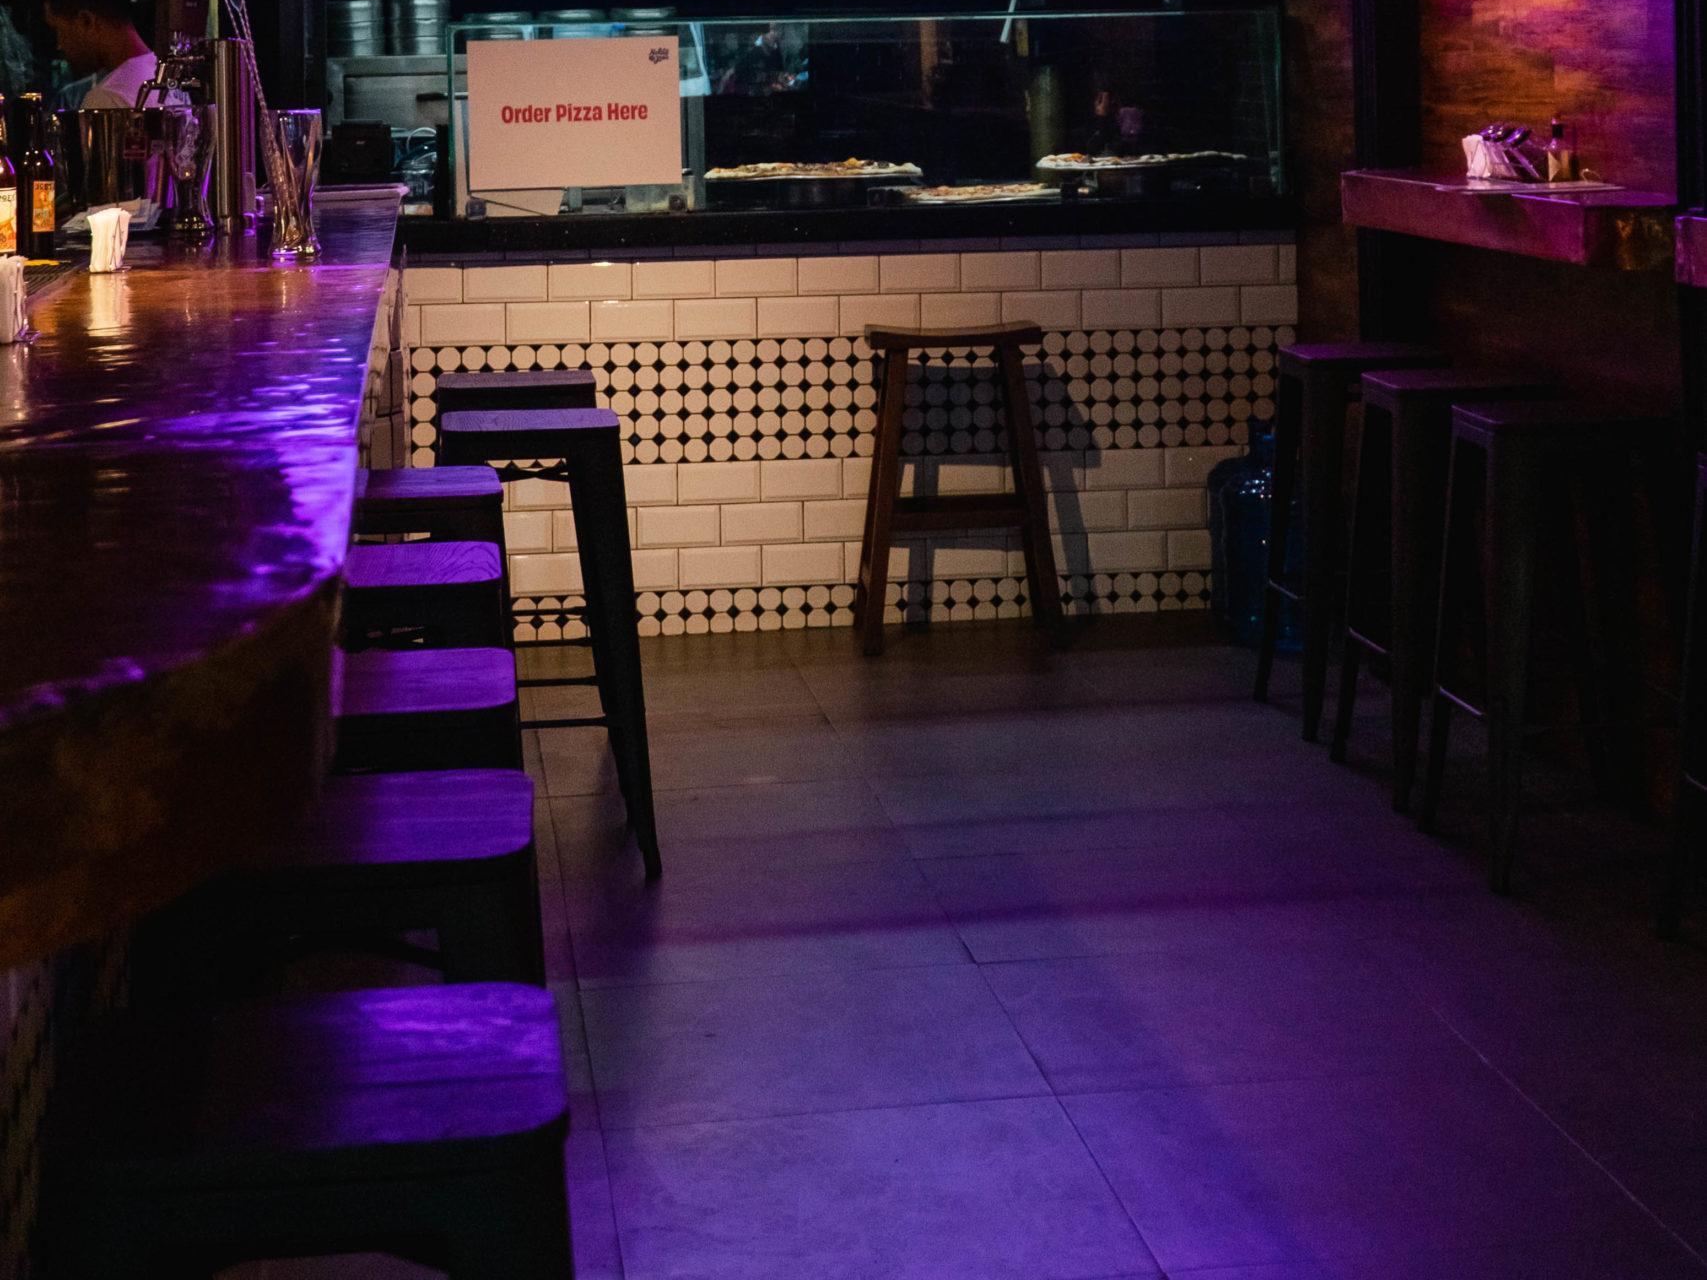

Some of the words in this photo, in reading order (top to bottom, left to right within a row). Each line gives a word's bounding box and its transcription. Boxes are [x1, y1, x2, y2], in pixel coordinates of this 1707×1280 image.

[501, 105, 551, 124] Order
[556, 103, 603, 122] Pizza
[607, 103, 648, 120] Here
